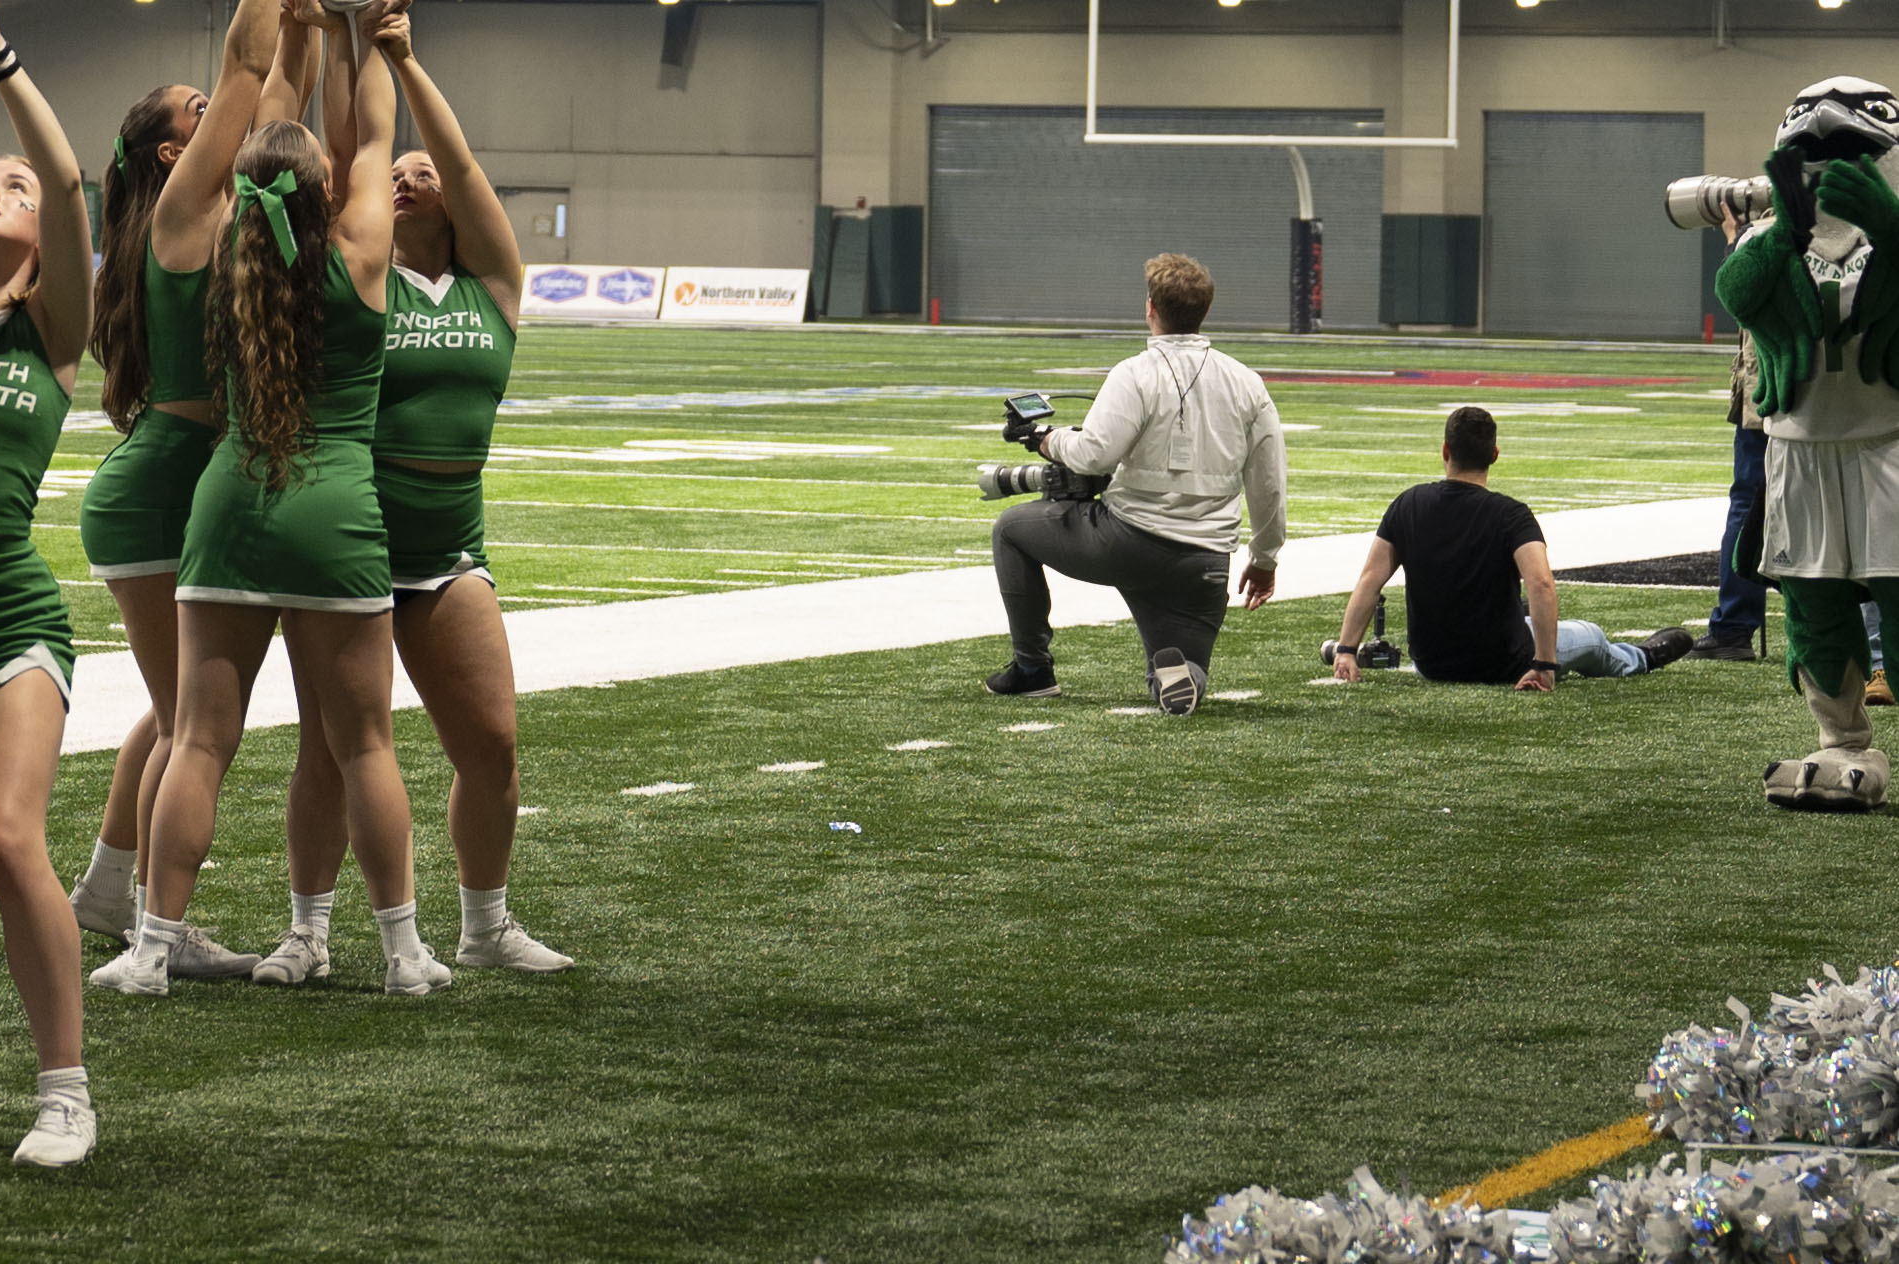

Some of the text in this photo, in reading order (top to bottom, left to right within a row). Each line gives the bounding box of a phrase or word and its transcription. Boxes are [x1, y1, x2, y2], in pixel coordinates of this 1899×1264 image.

[701, 285, 797, 303] Northern Valley
[393, 309, 483, 329] NORTH
[386, 331, 494, 351] DAKOTA
